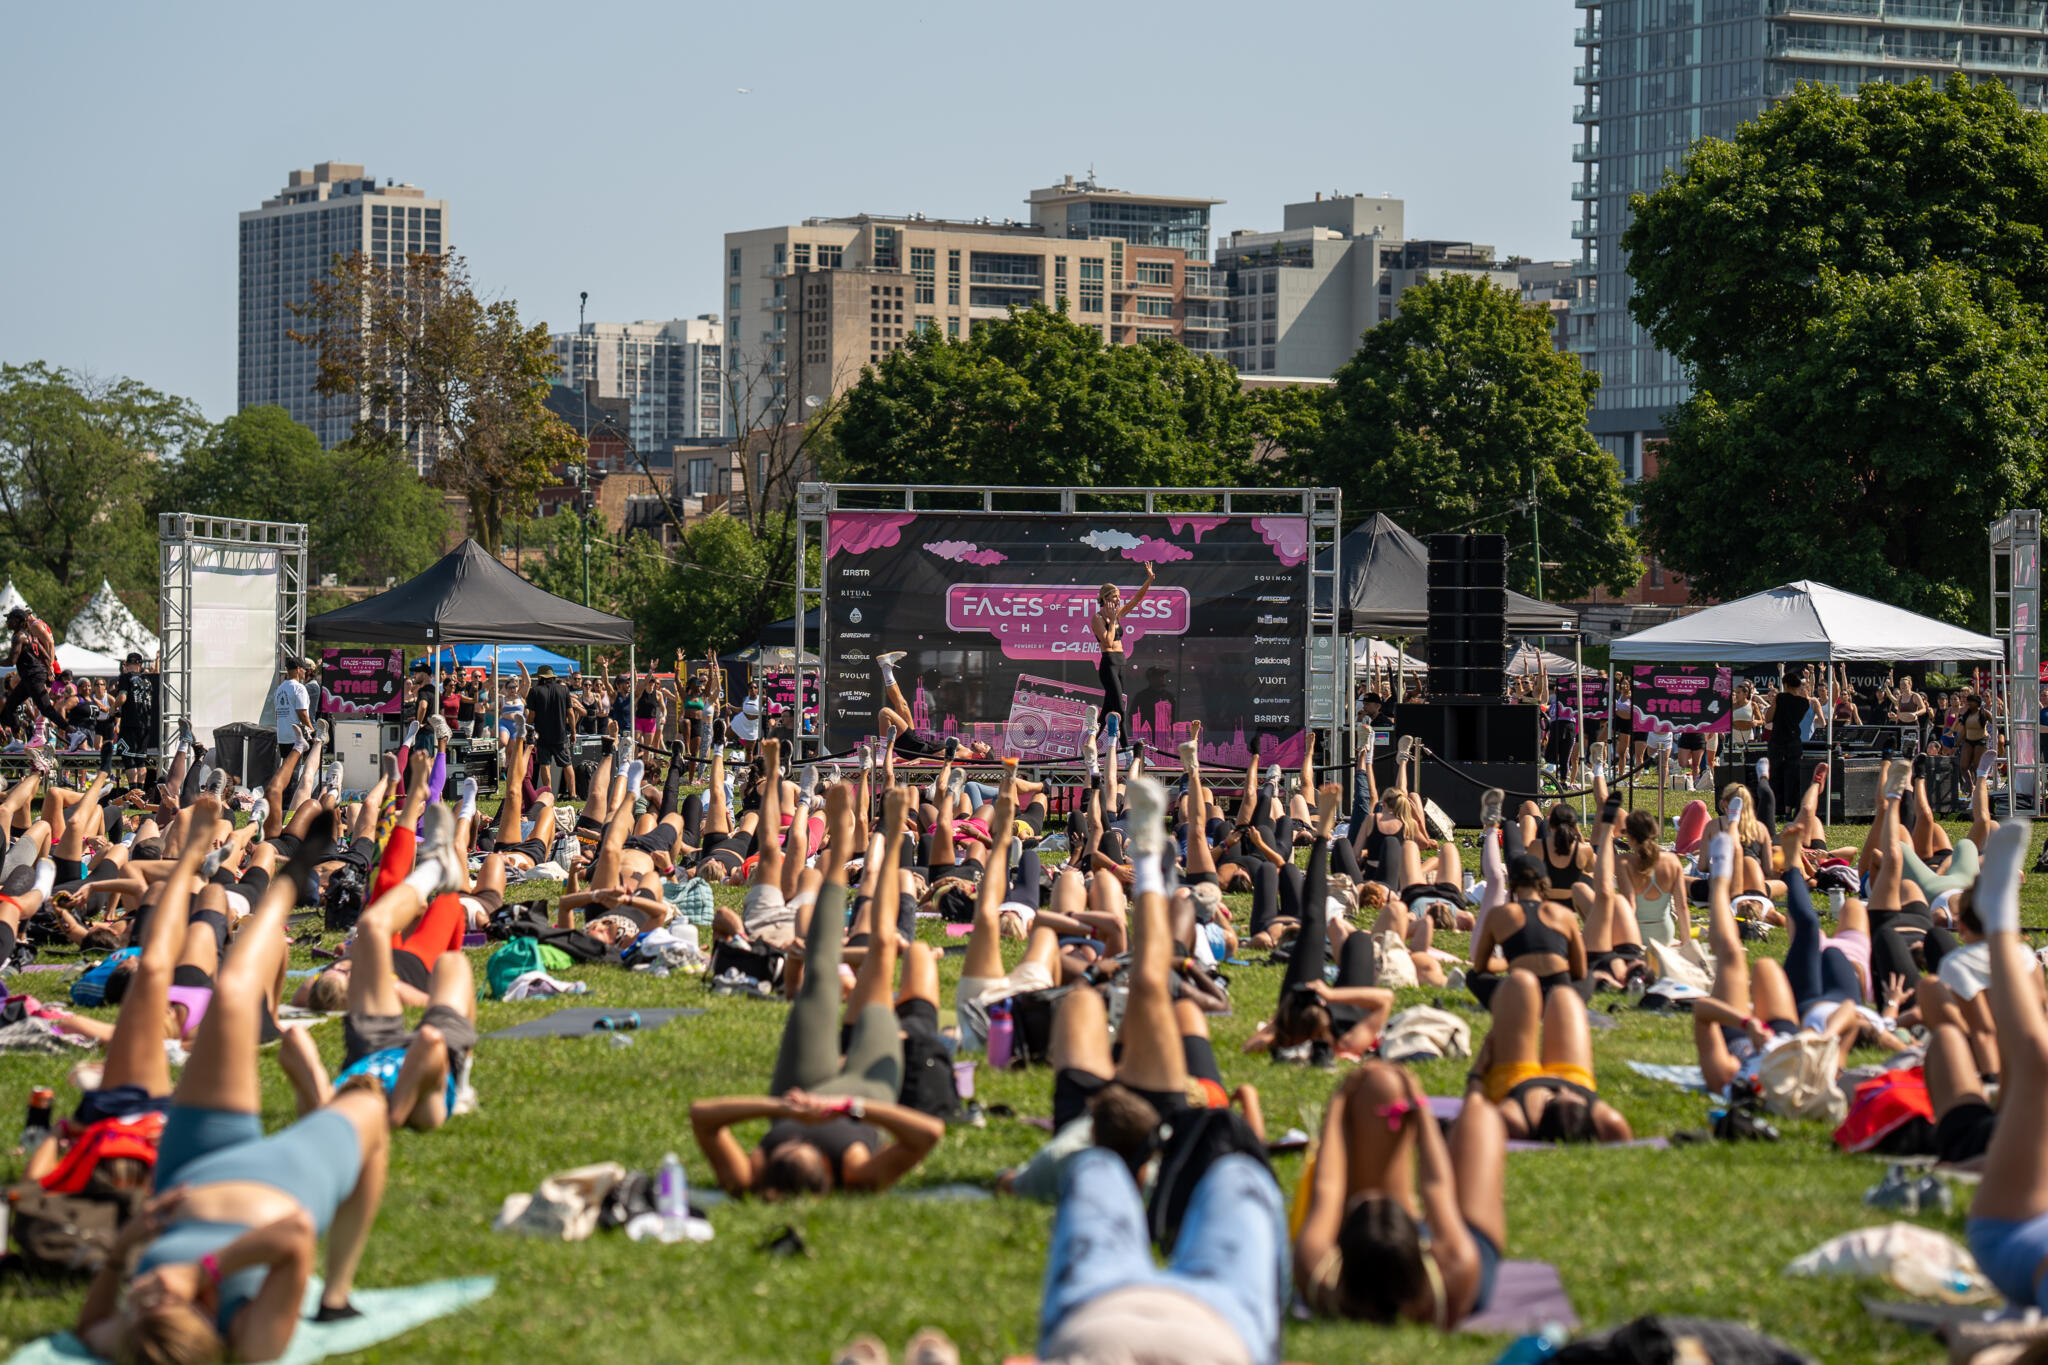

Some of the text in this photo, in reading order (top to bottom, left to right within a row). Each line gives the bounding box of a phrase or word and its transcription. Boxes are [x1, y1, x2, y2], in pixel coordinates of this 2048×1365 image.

[963, 596, 1043, 617] FACES
[1068, 598, 1172, 619] FITESS
[1000, 624, 1135, 634] CHICAO
[1051, 641, 1081, 653] C4
[333, 680, 393, 694] STAGE 4
[811, 693, 817, 702] 1
[1646, 699, 1720, 714] STAGE 4
